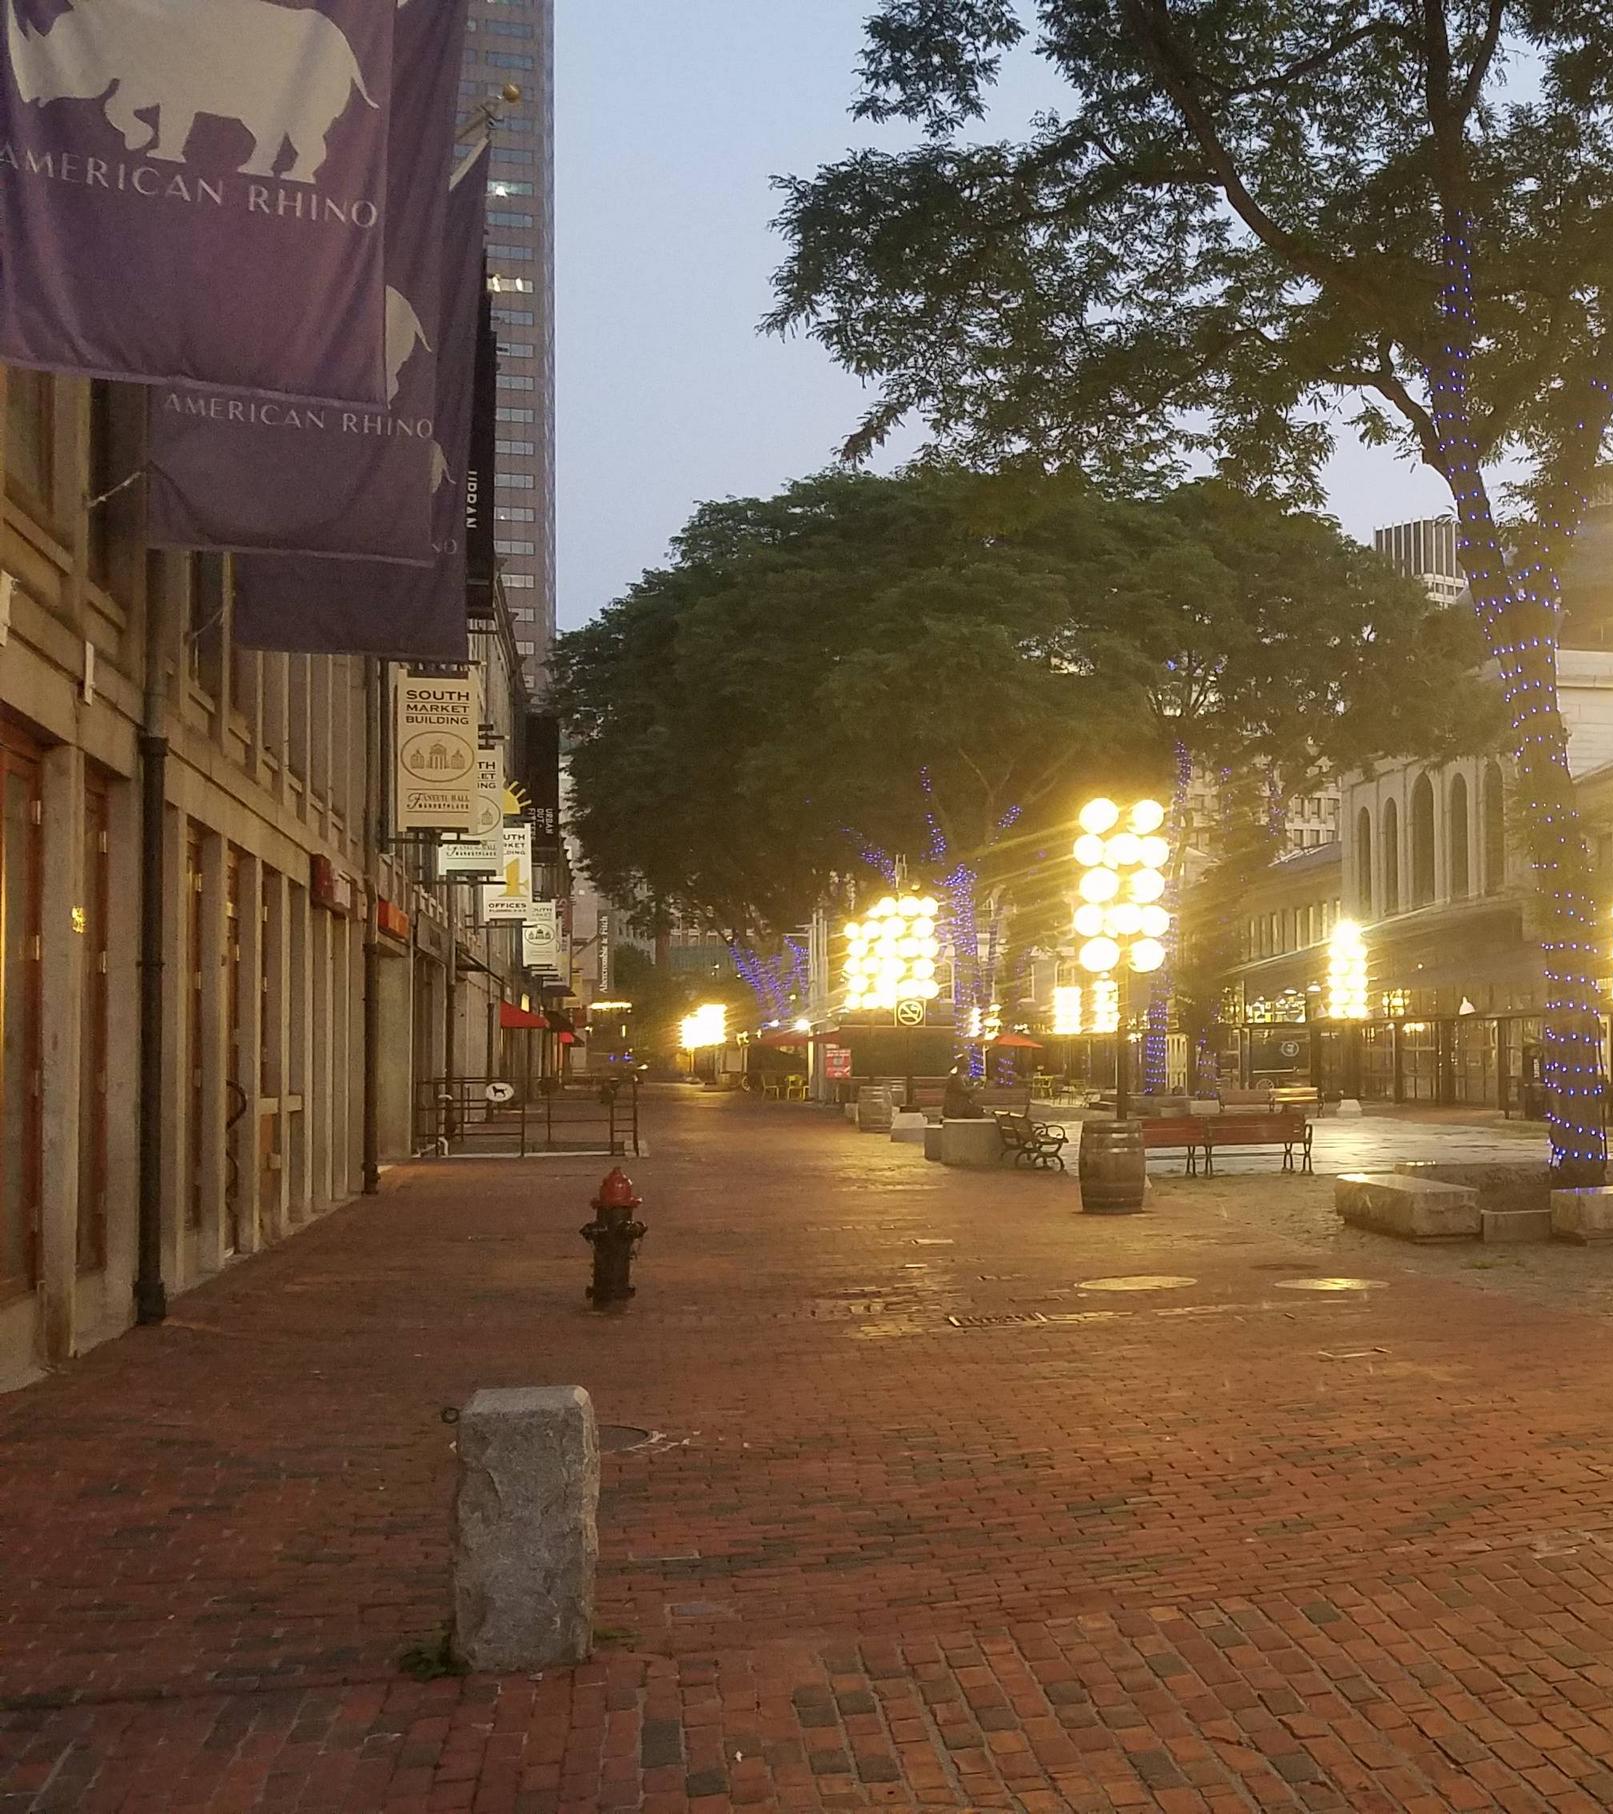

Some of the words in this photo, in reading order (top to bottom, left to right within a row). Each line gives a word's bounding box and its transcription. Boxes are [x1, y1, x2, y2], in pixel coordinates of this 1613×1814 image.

[0, 142, 223, 205] AMERICAN
[249, 184, 378, 228] RHINO
[166, 393, 325, 429] AMERICAN
[342, 412, 434, 439] RHINO
[406, 689, 470, 701] SOUTH
[406, 704, 470, 713] MARKET
[405, 716, 469, 725] BUILDING
[599, 916, 608, 936] Fitch
[599, 946, 608, 994] Abercrombie
